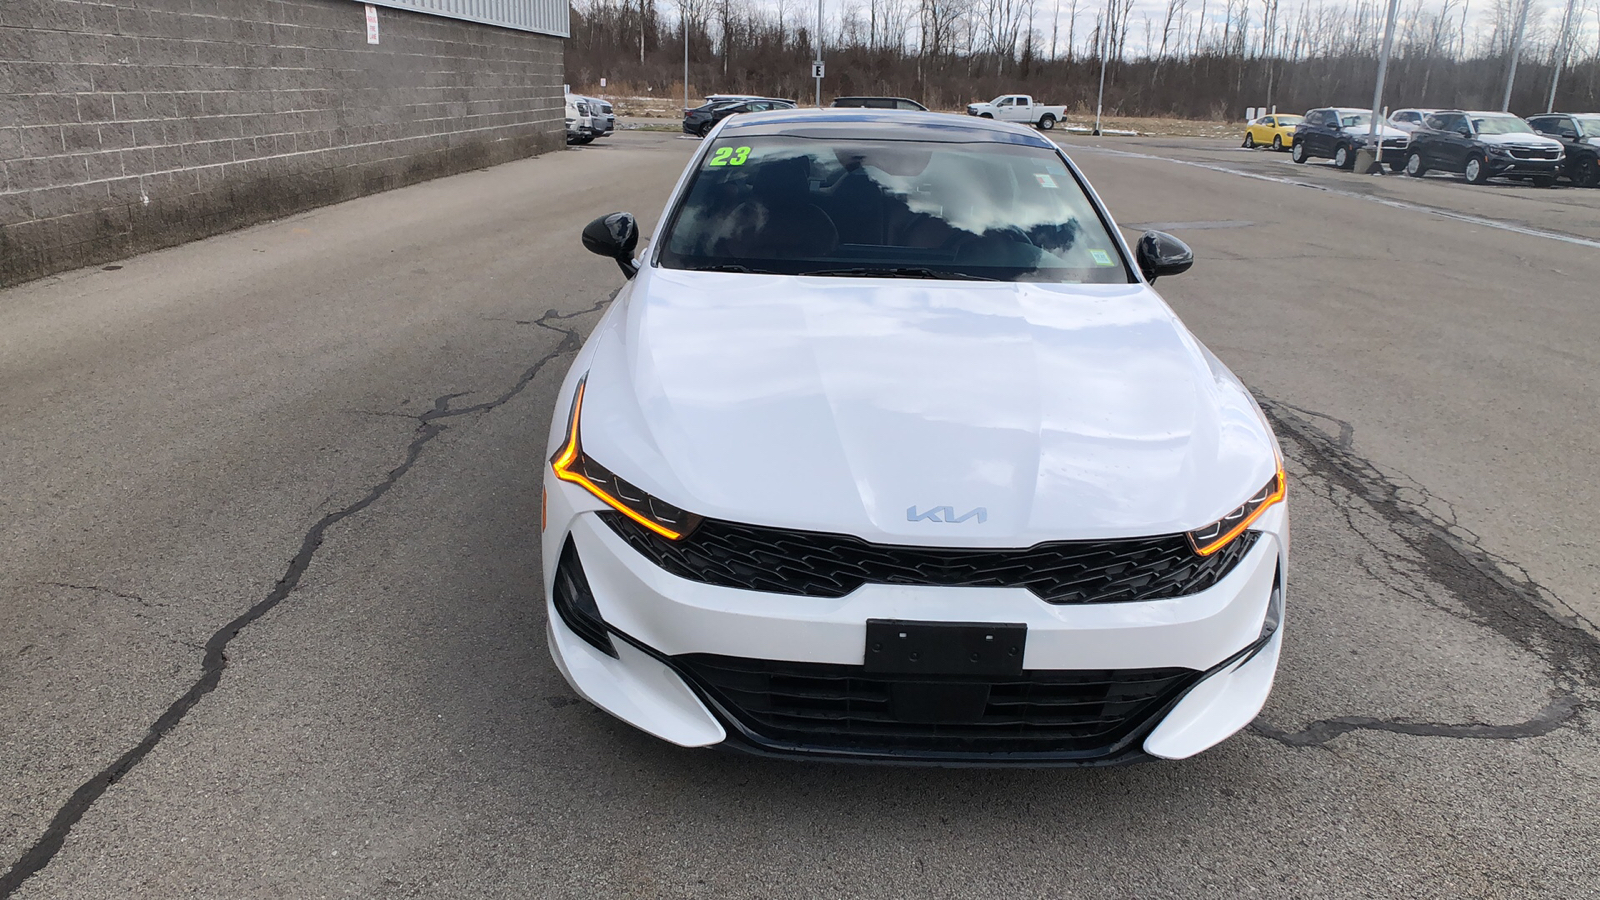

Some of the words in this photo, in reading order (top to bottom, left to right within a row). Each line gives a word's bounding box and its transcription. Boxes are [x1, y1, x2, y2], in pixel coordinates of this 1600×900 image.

[816, 66, 821, 76] E
[709, 146, 751, 166] 23
[907, 505, 987, 523] KIA
